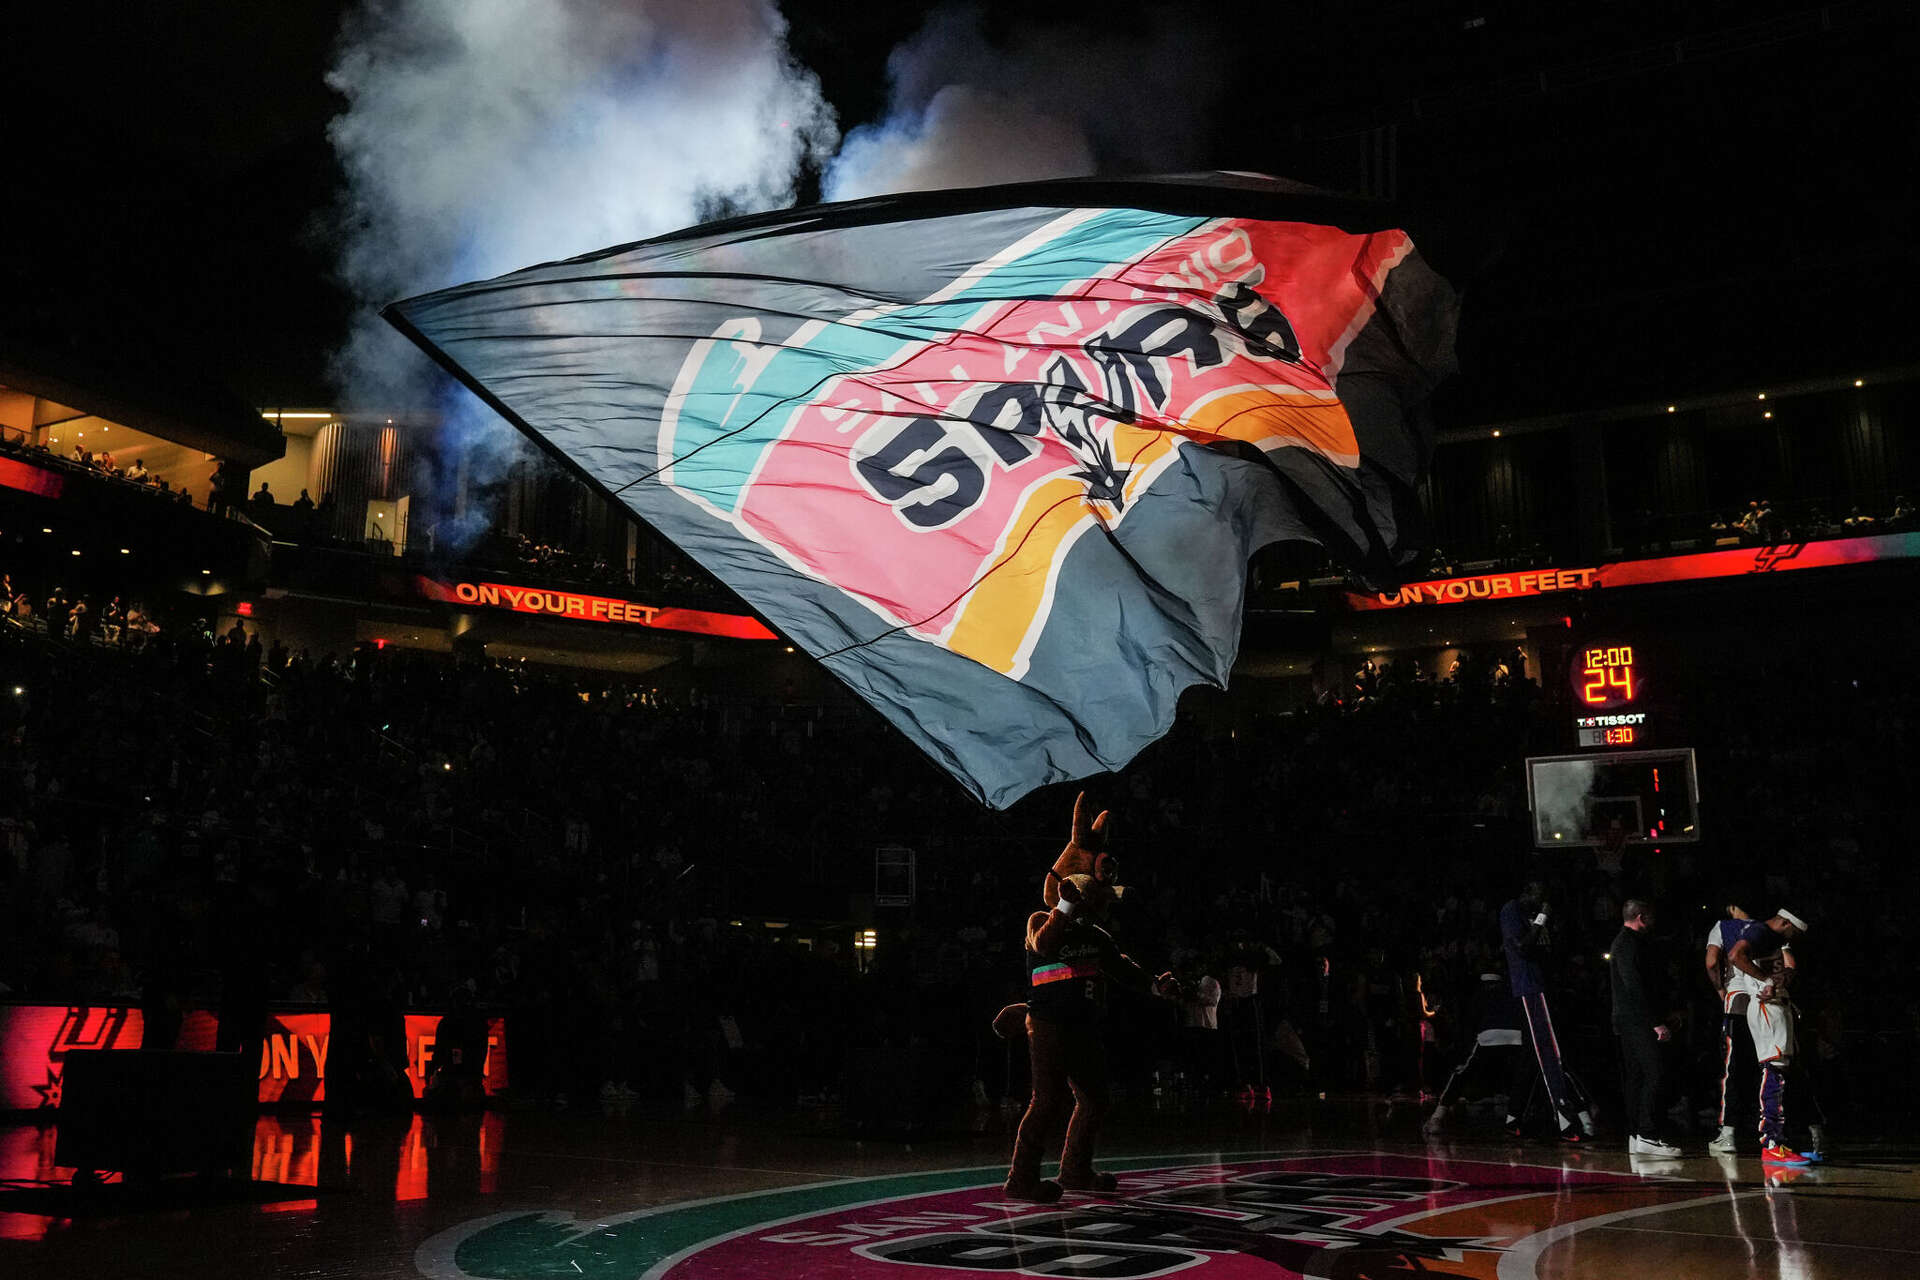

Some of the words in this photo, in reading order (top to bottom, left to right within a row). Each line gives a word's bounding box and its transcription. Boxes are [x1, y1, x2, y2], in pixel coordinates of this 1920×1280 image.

[1426, 577, 1513, 602] YOUR
[1519, 567, 1598, 593] FEET
[456, 583, 499, 605] ON
[502, 588, 586, 615] YOUR
[591, 600, 660, 624] FEET
[1586, 646, 1633, 668] 12:00
[1583, 666, 1633, 702] 24
[1596, 713, 1646, 727] TISSOT
[1606, 728, 1633, 743] 1:30
[759, 1211, 990, 1247] SAN
